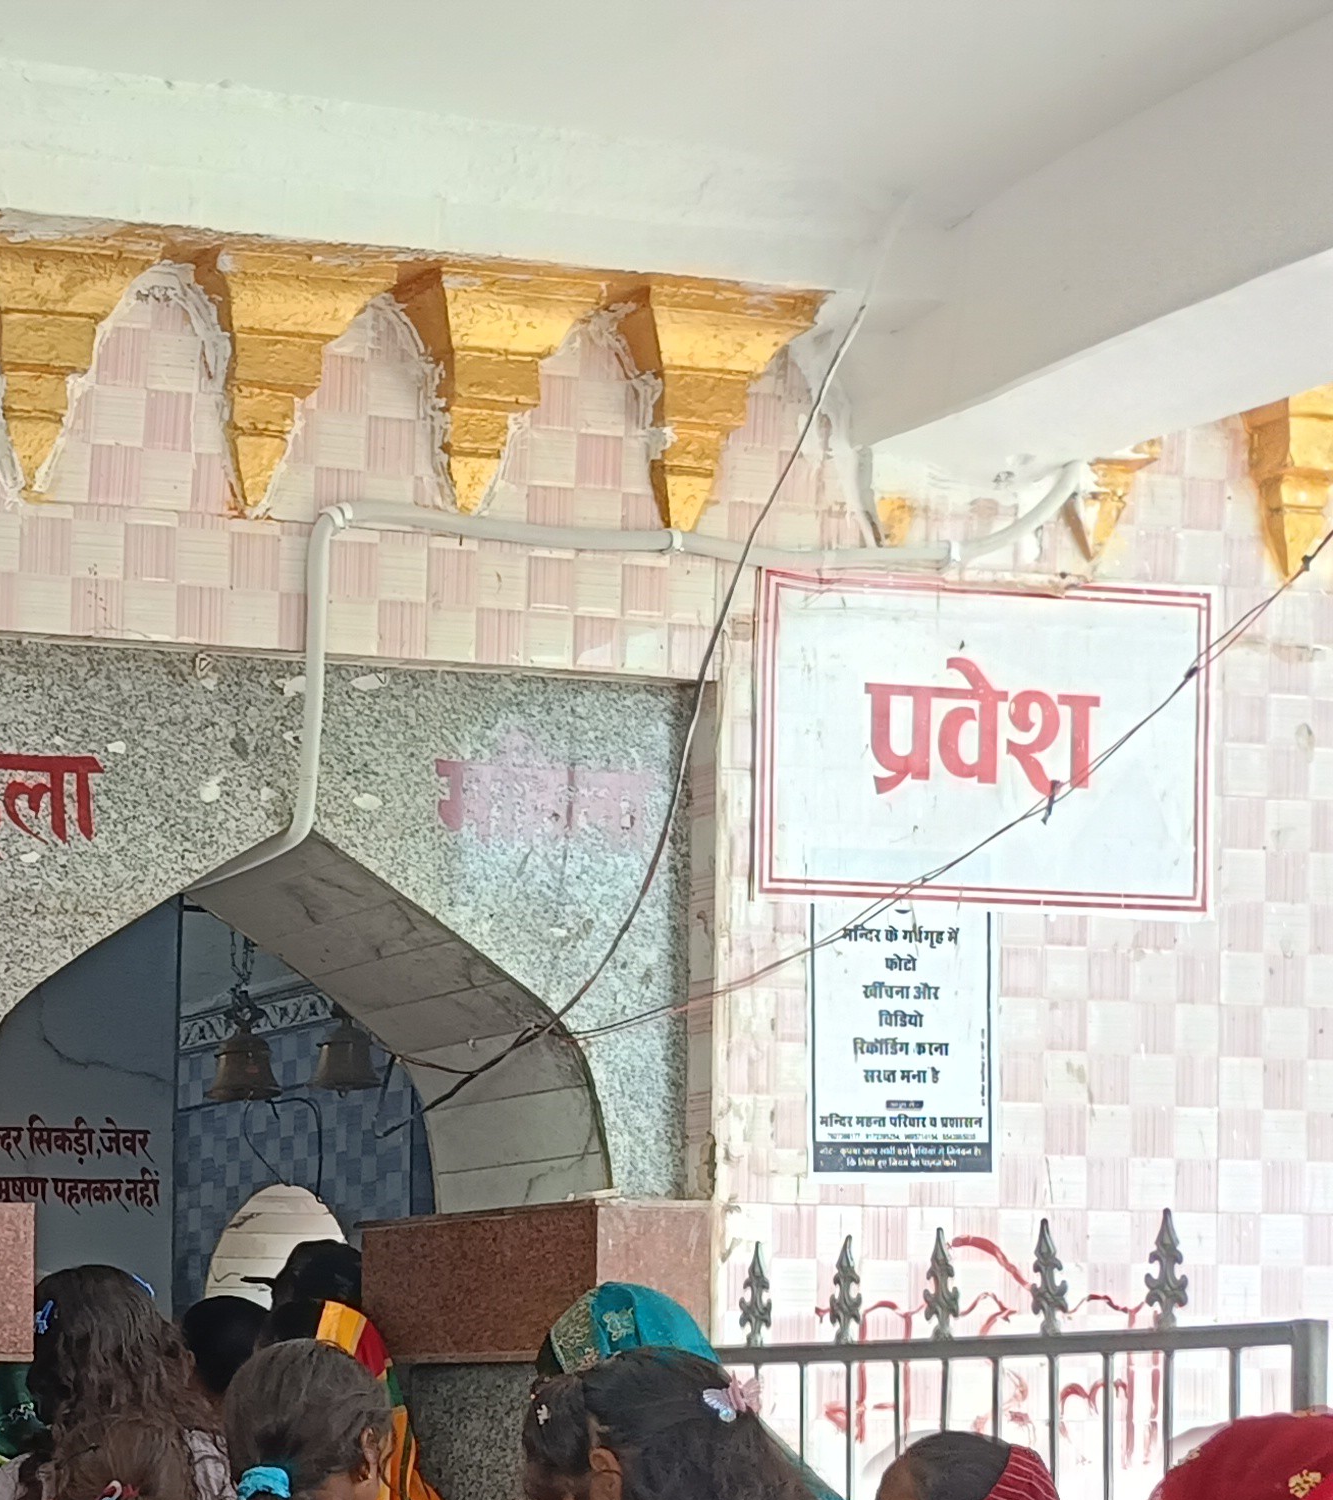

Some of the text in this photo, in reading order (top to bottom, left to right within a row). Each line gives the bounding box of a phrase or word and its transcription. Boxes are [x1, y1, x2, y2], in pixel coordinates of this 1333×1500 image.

[864, 656, 1101, 795] प्रवेश
[885, 953, 918, 972] फोटो
[913, 981, 941, 1000] और
[915, 1041, 950, 1057] करना
[900, 1069, 928, 1084] मना
[819, 1113, 854, 1128] मन्दिर
